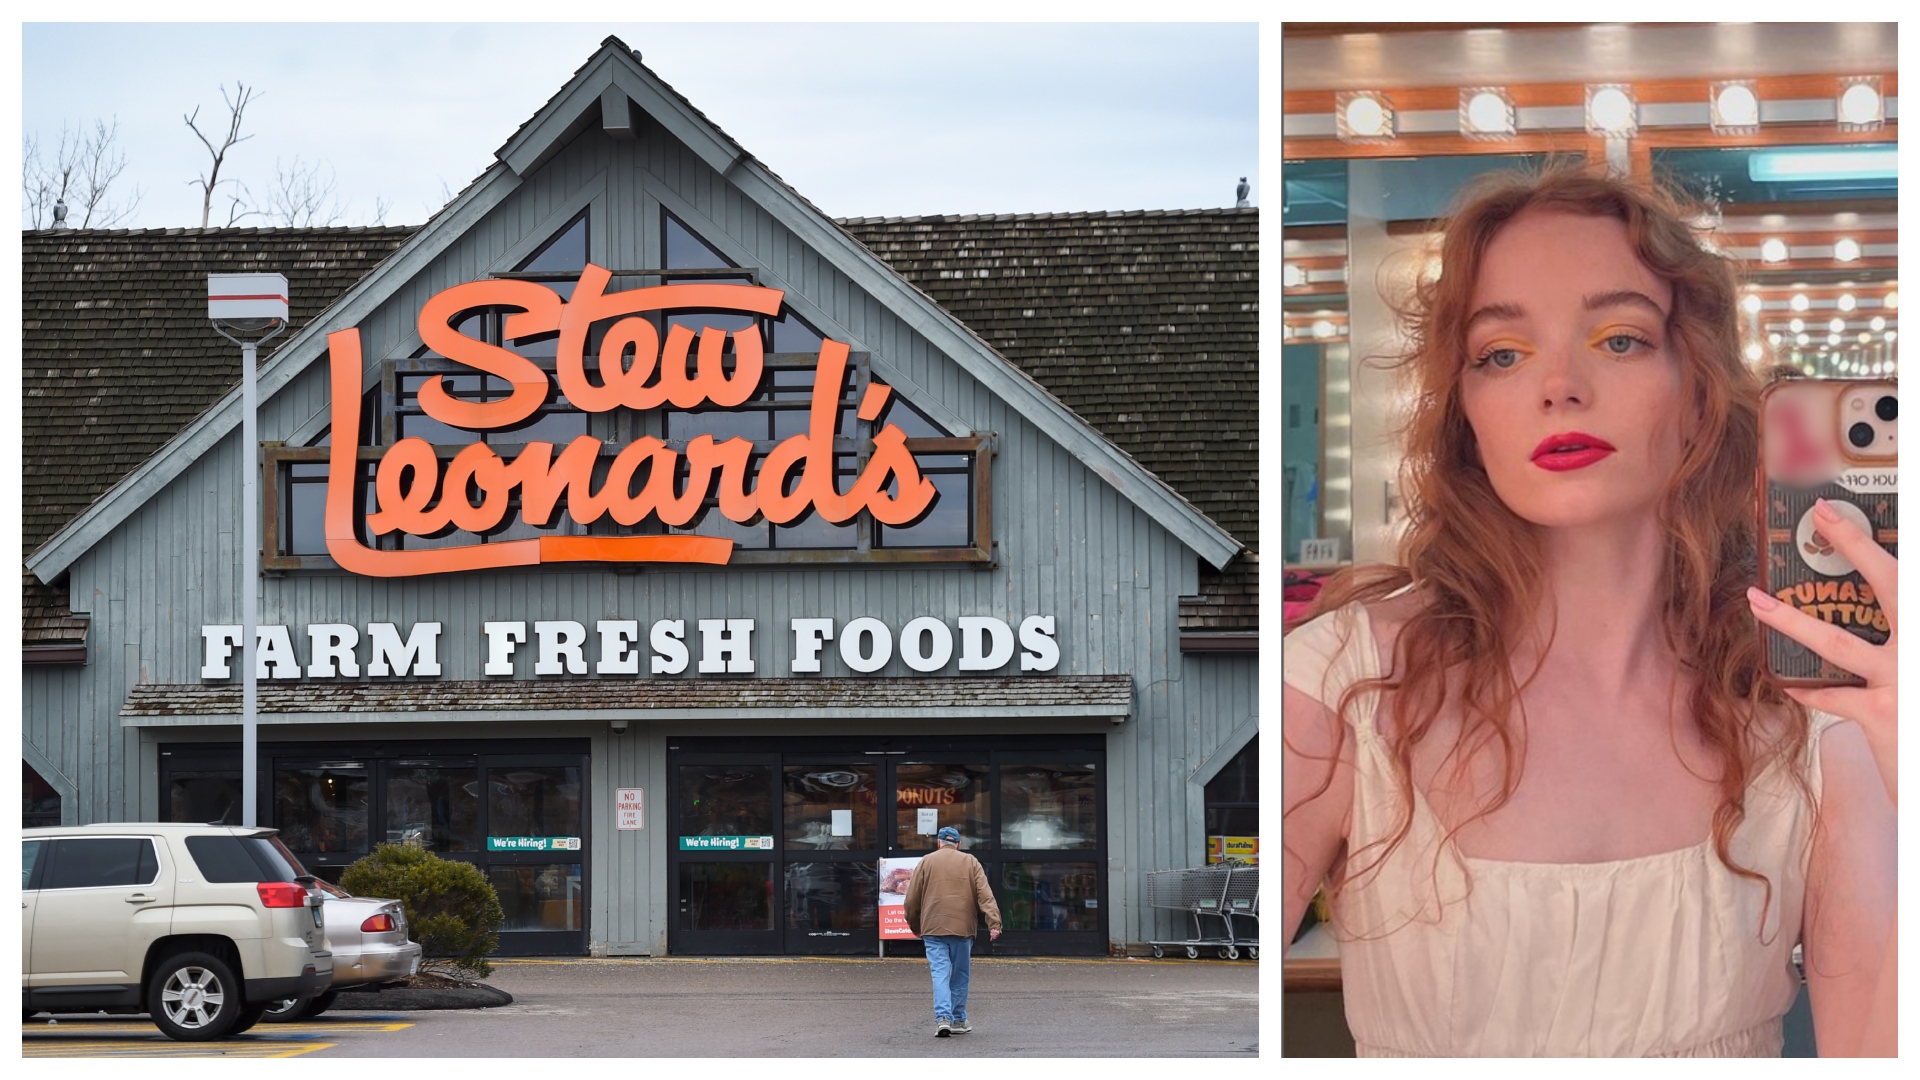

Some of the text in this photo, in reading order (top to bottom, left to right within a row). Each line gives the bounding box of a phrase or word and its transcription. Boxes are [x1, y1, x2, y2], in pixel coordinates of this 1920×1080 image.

[417, 264, 785, 429] Stew
[325, 326, 936, 577] Leonard's
[201, 615, 1060, 679] FARM FRESH FOODS
[624, 792, 635, 801] NO
[618, 802, 642, 811] PARKING
[493, 838, 547, 850] We're Hiring!
[686, 837, 740, 849] We're Hiring!
